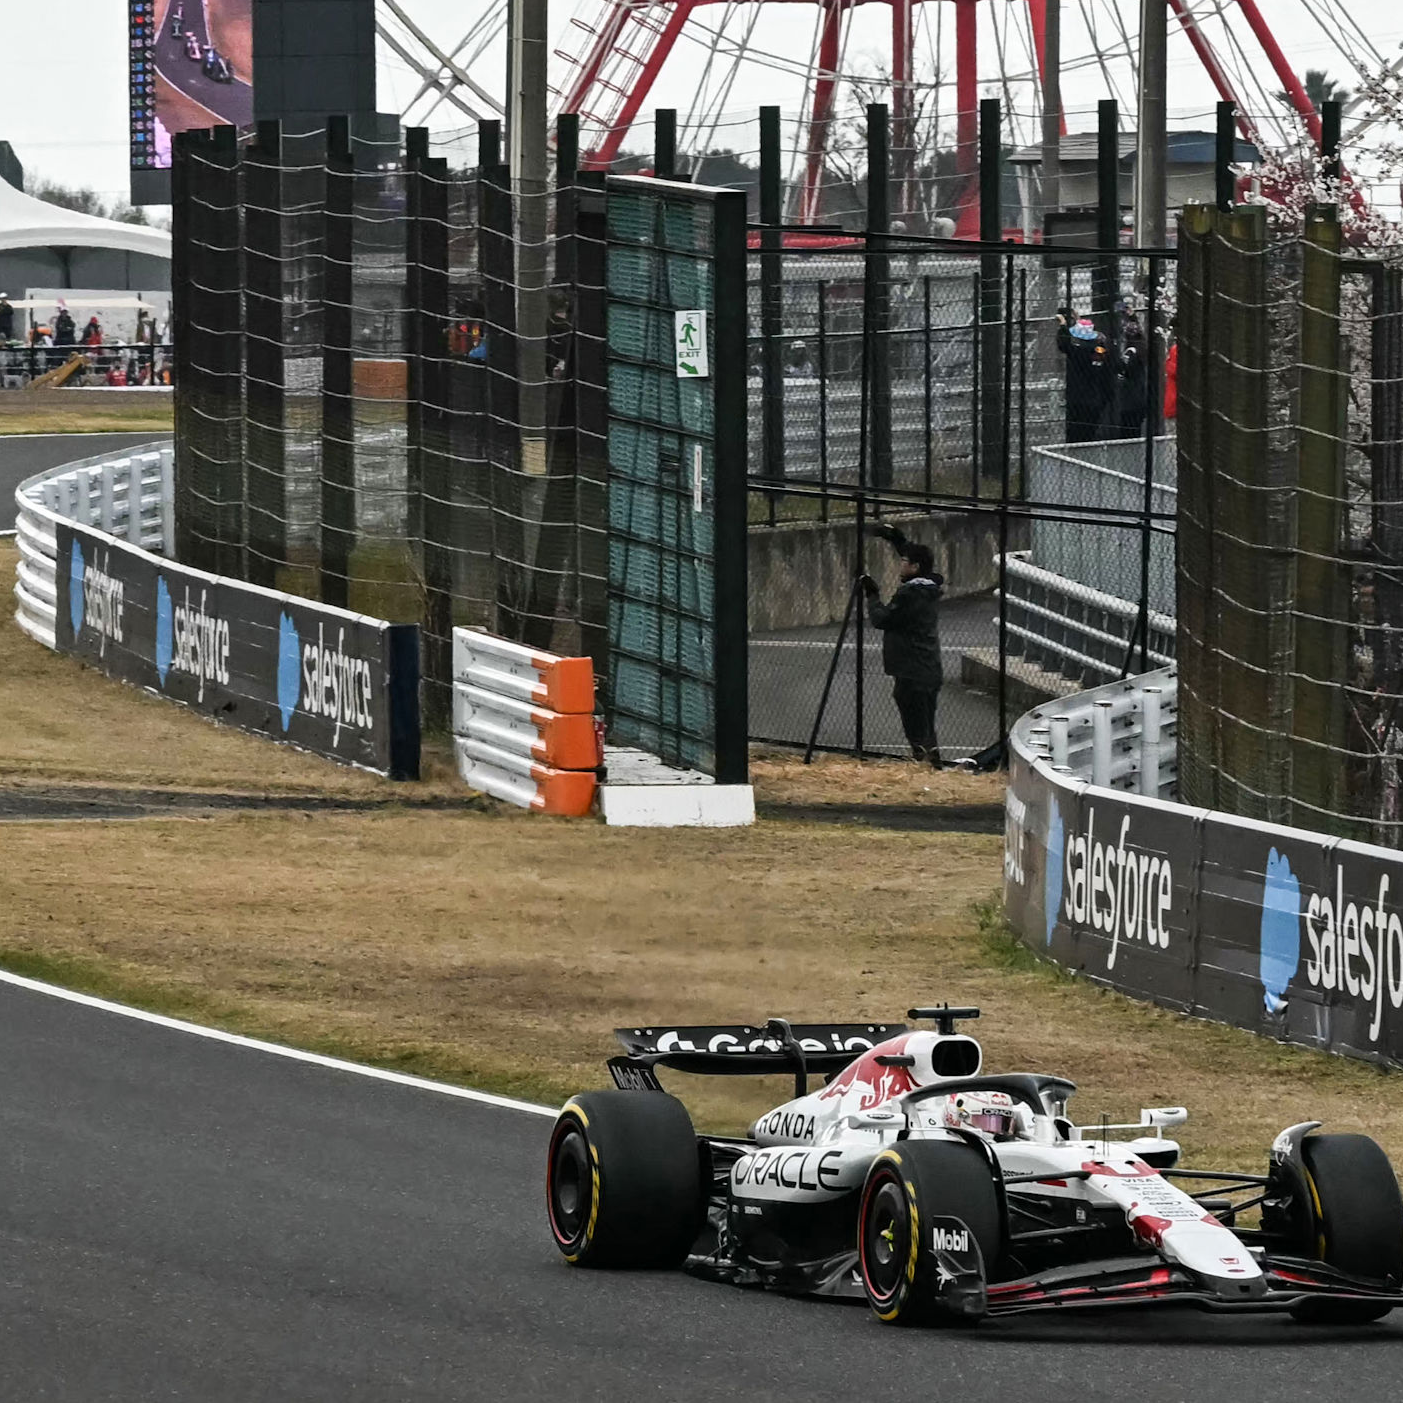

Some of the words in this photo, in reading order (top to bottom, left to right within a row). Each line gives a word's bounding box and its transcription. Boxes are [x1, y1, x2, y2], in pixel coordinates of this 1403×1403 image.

[679, 351, 701, 359] EXIT
[84, 549, 125, 658] salesforce
[173, 584, 230, 703] salesforce
[302, 622, 374, 748] salesforce
[1065, 807, 1173, 970] salesforce
[611, 1065, 648, 1091] Mobil
[758, 1111, 815, 1141] HONDA
[735, 1150, 853, 1192] ORACLE
[932, 1227, 969, 1253] Mobil
